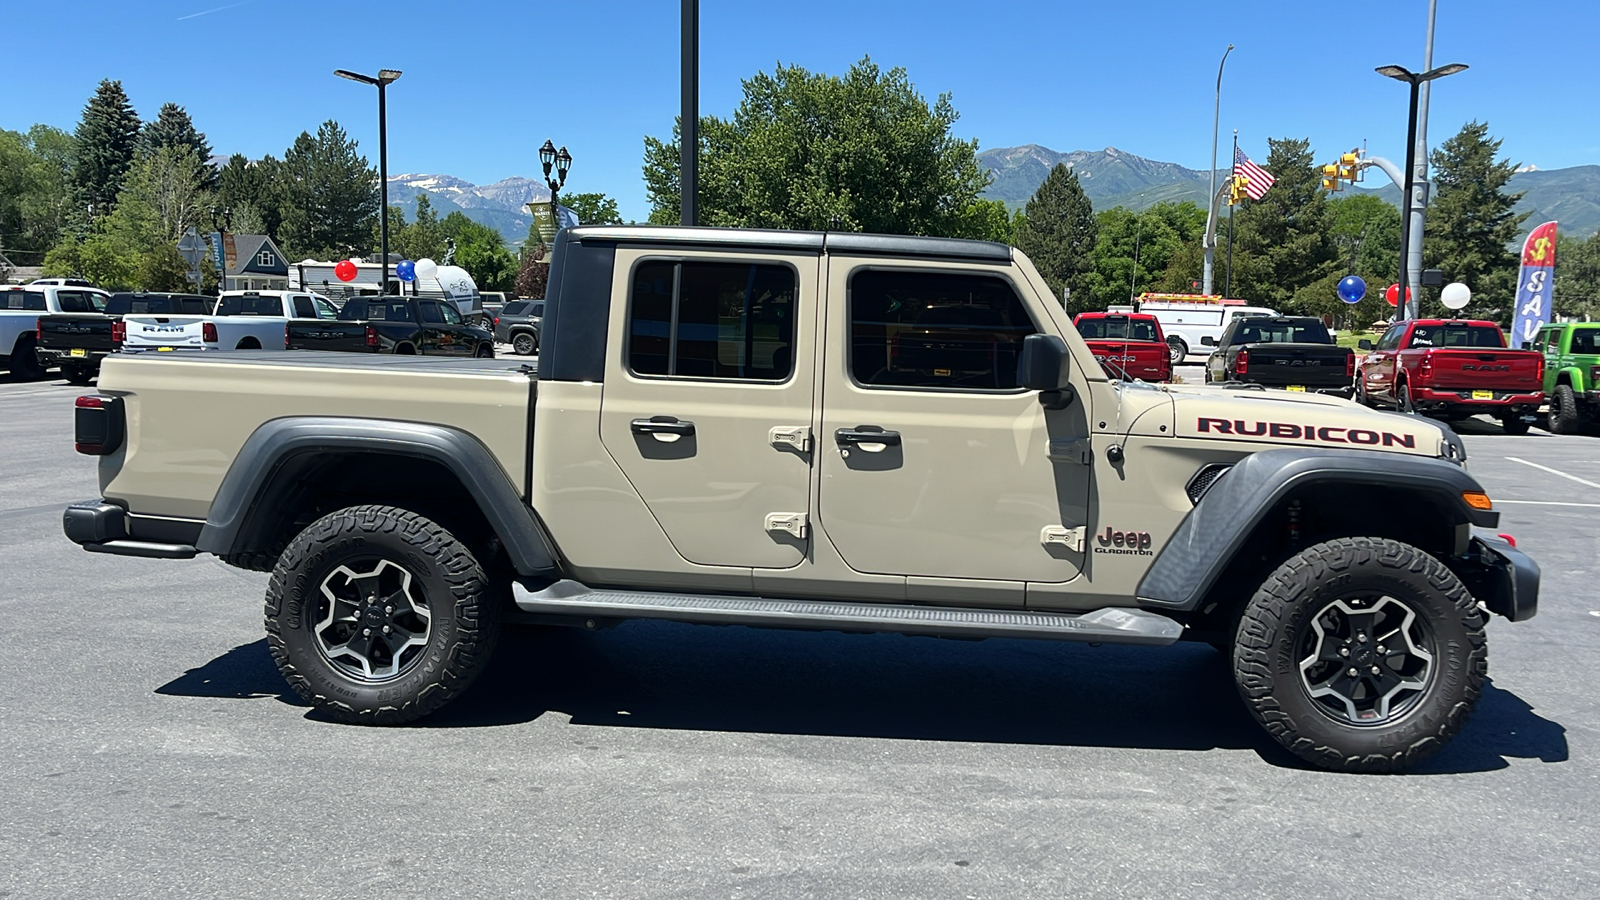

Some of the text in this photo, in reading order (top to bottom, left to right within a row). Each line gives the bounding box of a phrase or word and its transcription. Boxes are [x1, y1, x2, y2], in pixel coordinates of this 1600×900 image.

[57, 326, 92, 334] RAM
[142, 325, 185, 333] RAM
[1274, 359, 1321, 367] RAM
[1461, 363, 1510, 372] RAM
[1196, 416, 1416, 449] RUBICON
[1097, 526, 1152, 551] Jeep
[1094, 547, 1154, 557] GLADIATOR
[376, 617, 450, 702] WRANGLER
